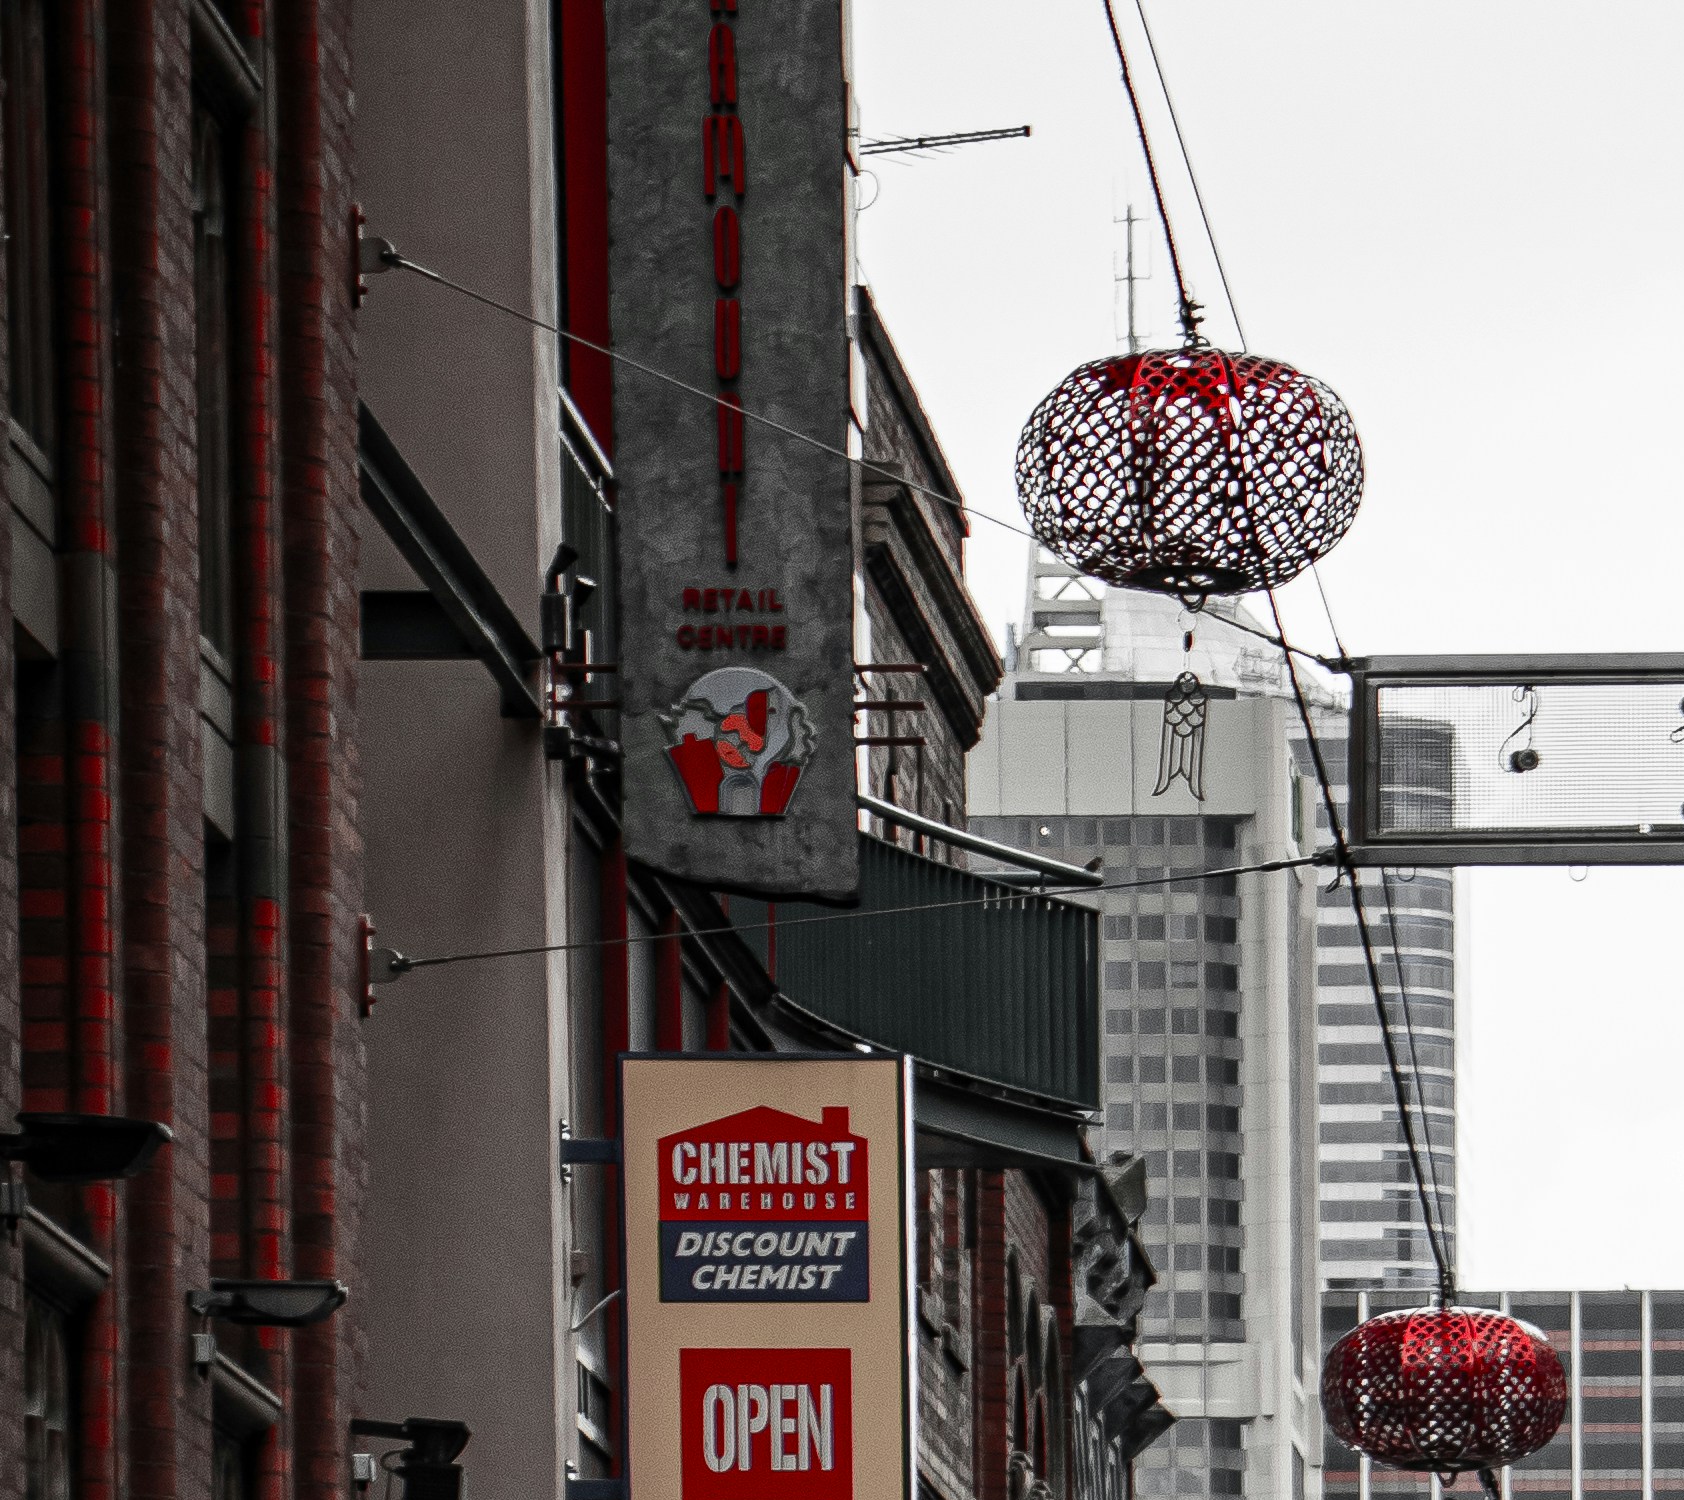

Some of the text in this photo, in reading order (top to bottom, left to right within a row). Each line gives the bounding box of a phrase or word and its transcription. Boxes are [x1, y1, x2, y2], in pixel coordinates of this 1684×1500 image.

[682, 587, 785, 613] RETAIL
[676, 624, 788, 650] CENTRE
[672, 1141, 857, 1185] CHEMIST
[674, 1192, 856, 1210] WAREHOUSE
[675, 1231, 857, 1257] DISCOUNT
[692, 1264, 843, 1290] CHEMIST
[702, 1384, 835, 1473] OPEN
